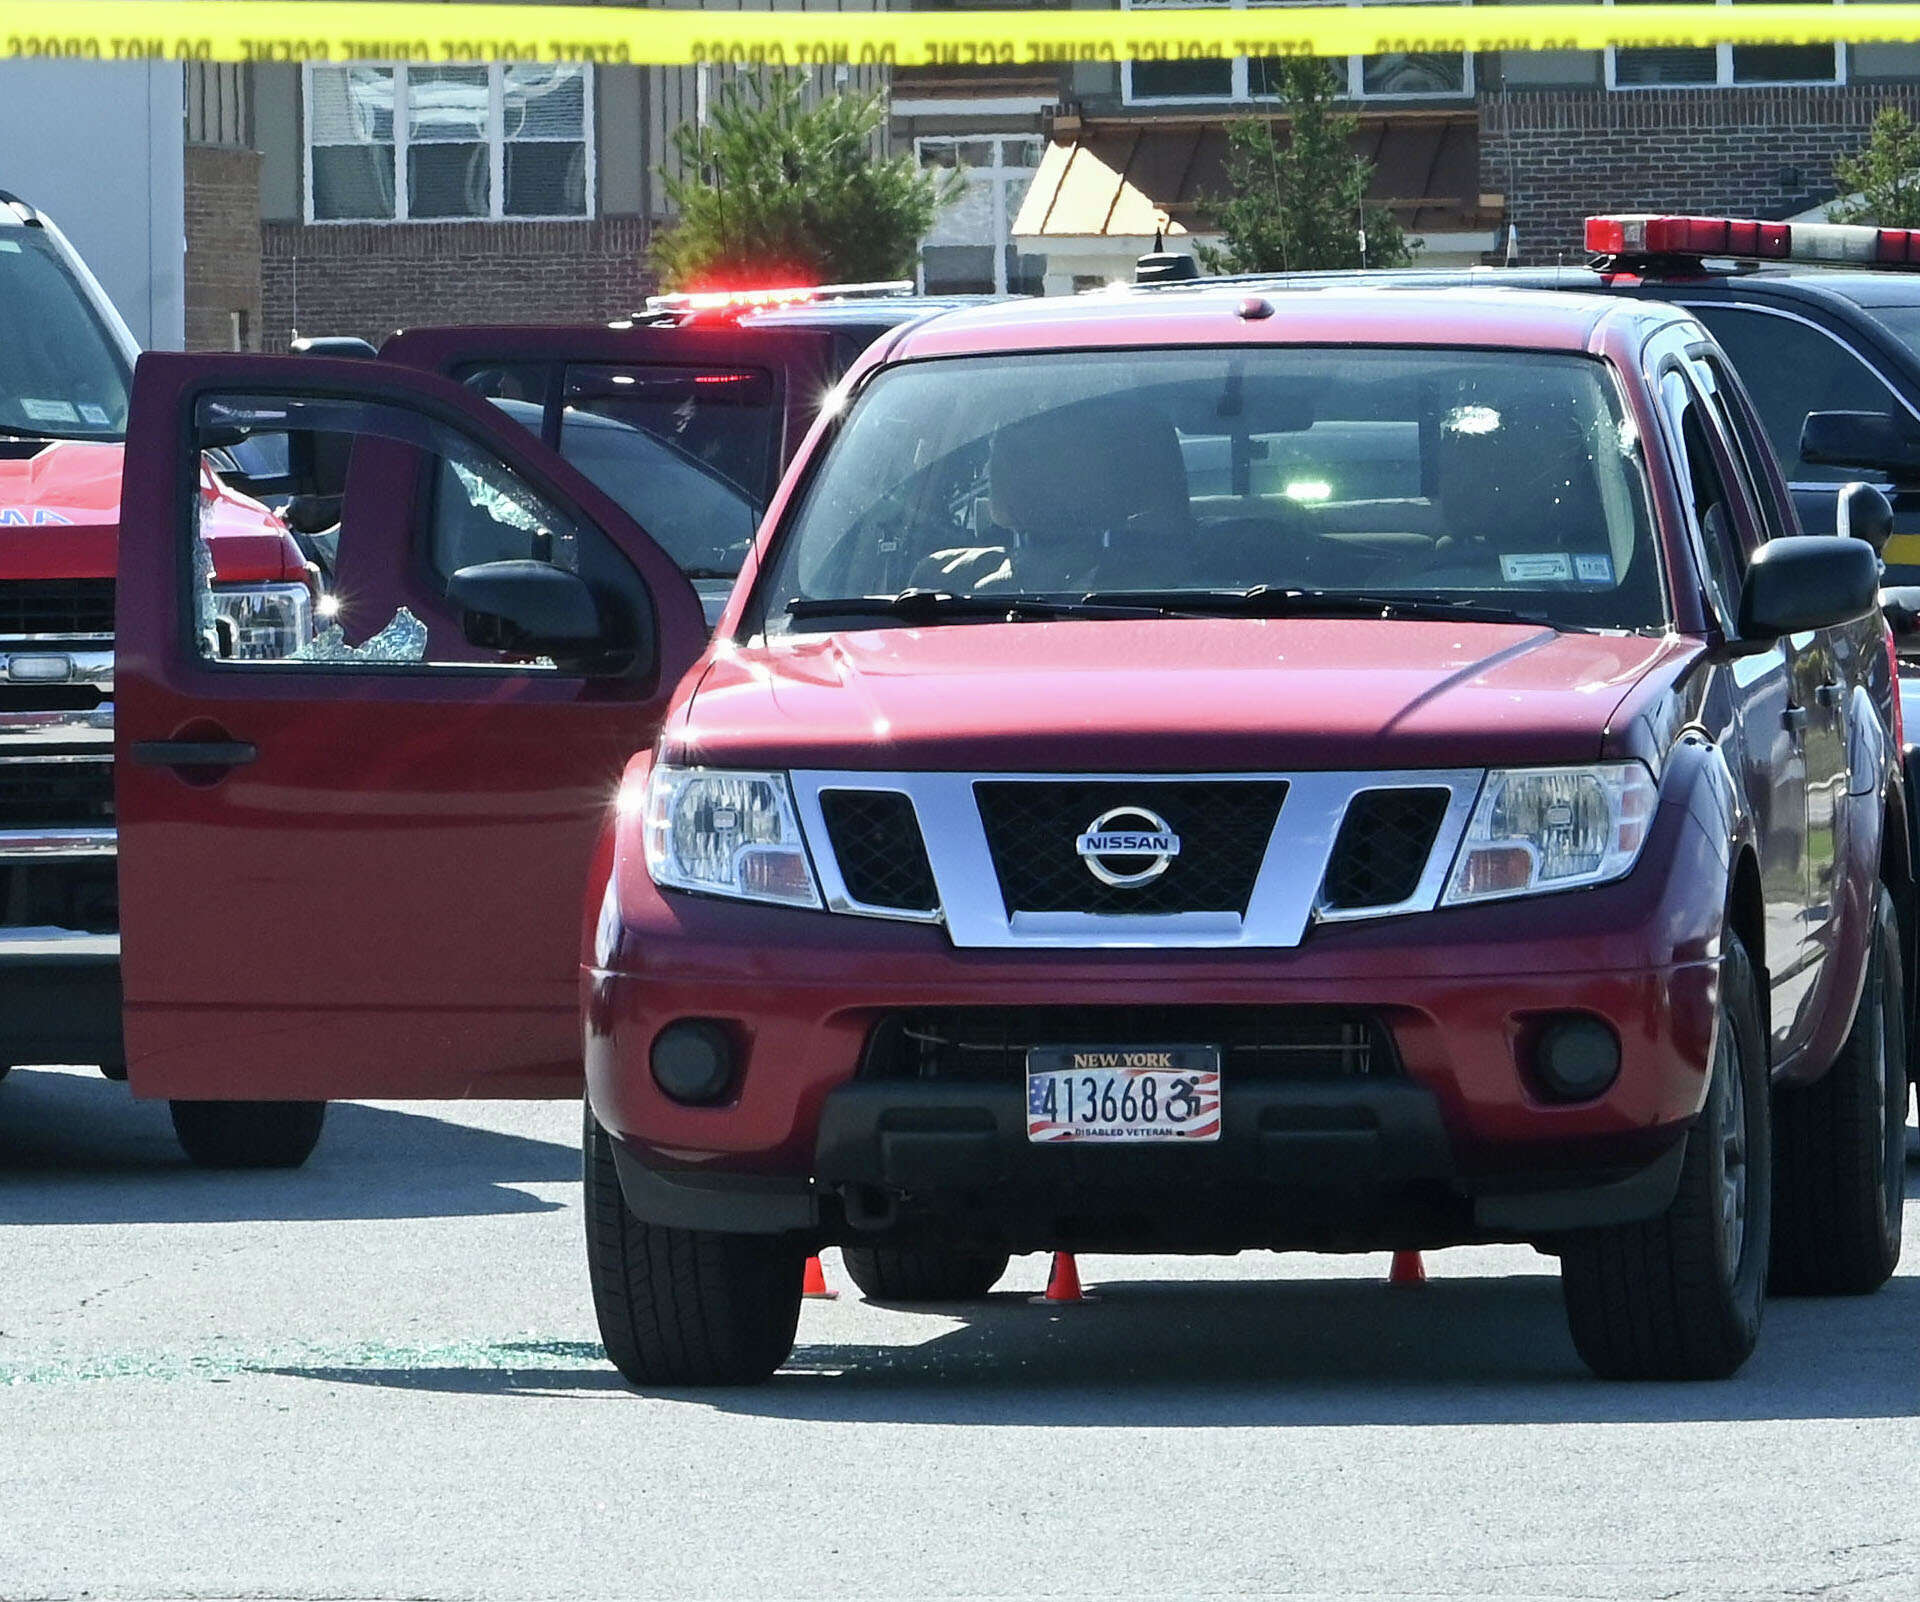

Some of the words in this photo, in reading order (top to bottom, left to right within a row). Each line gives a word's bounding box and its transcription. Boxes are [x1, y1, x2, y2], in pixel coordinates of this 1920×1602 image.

[1087, 837, 1168, 850] NISSAN
[1074, 1054, 1118, 1067] NEW
[1123, 1053, 1171, 1066] YORK
[1043, 1077, 1157, 1123] 413668
[1075, 1128, 1123, 1137] DISABLED
[1126, 1128, 1172, 1137] VETERAN
